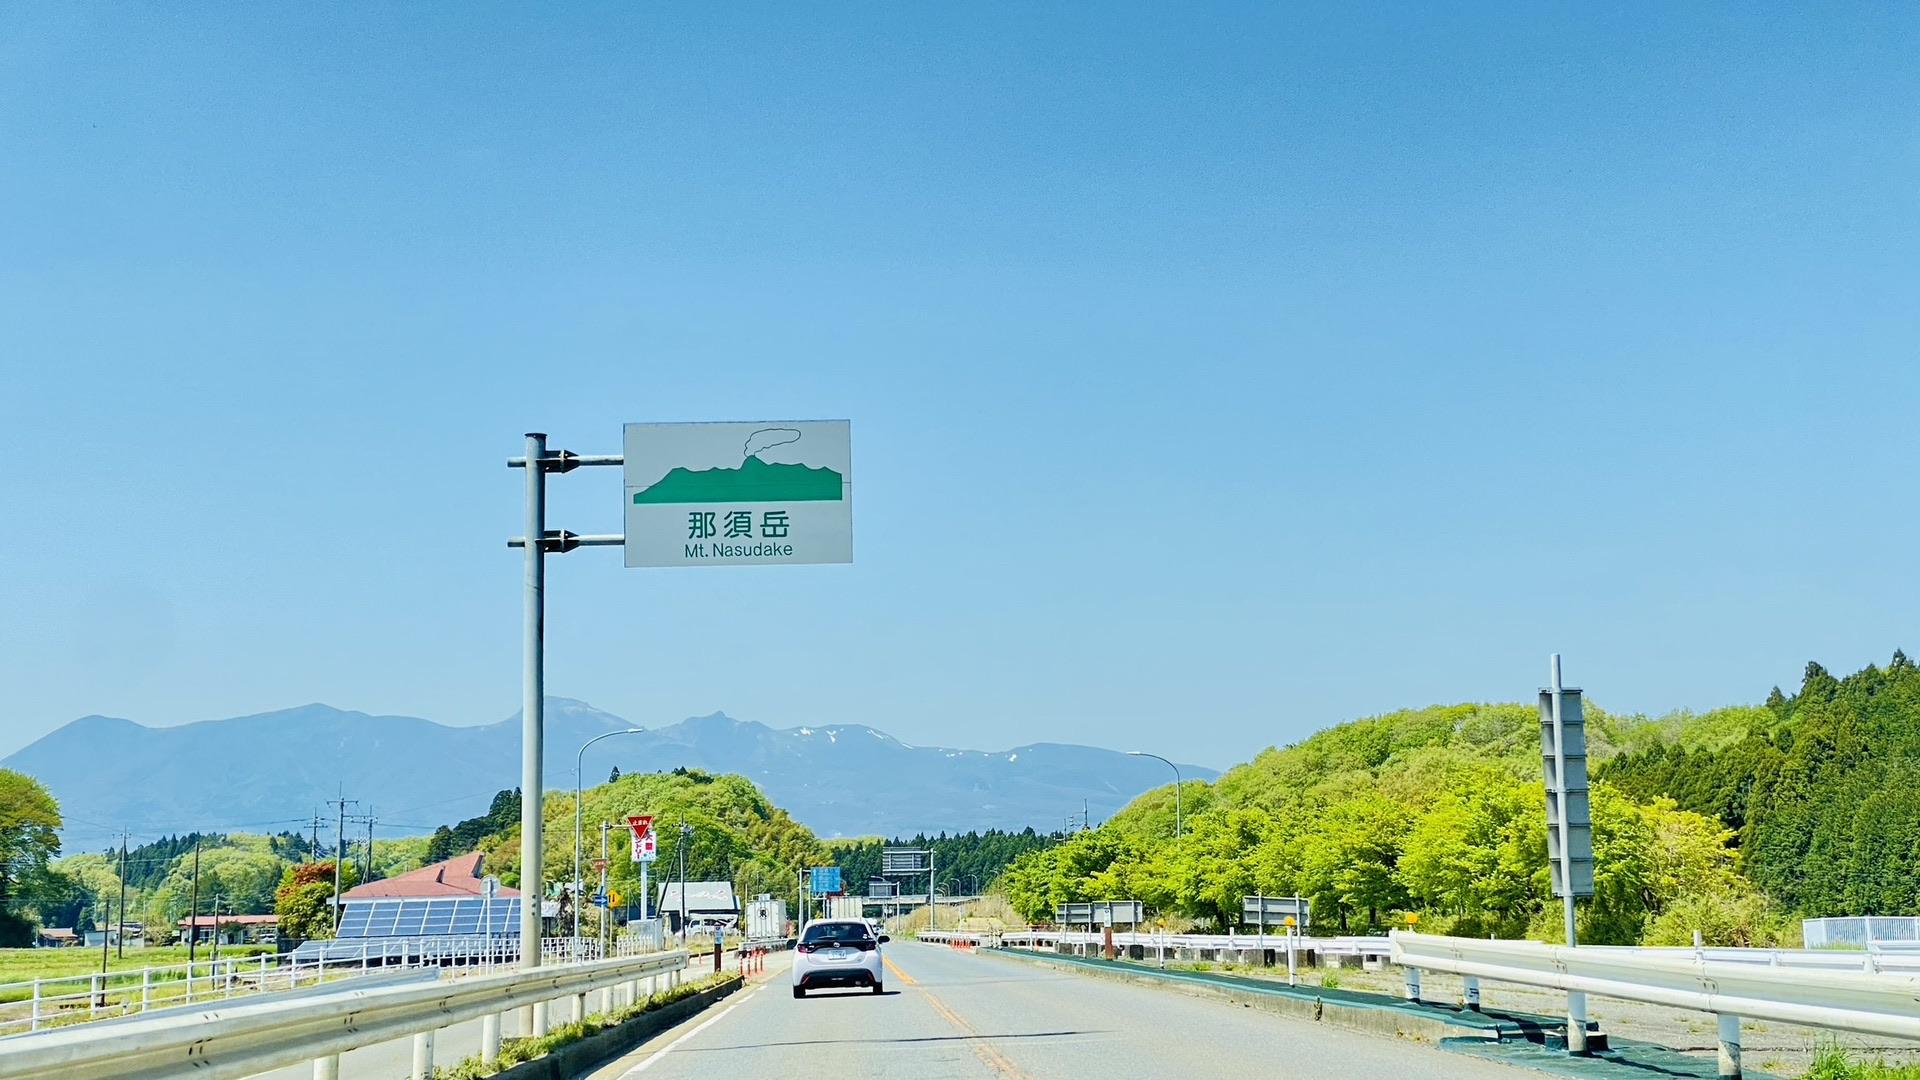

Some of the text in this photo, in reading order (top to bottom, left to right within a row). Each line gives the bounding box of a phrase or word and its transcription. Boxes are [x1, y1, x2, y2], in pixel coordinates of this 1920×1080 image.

[688, 511, 789, 539] 那須岳
[685, 542, 793, 558] Mt. Nasudake
